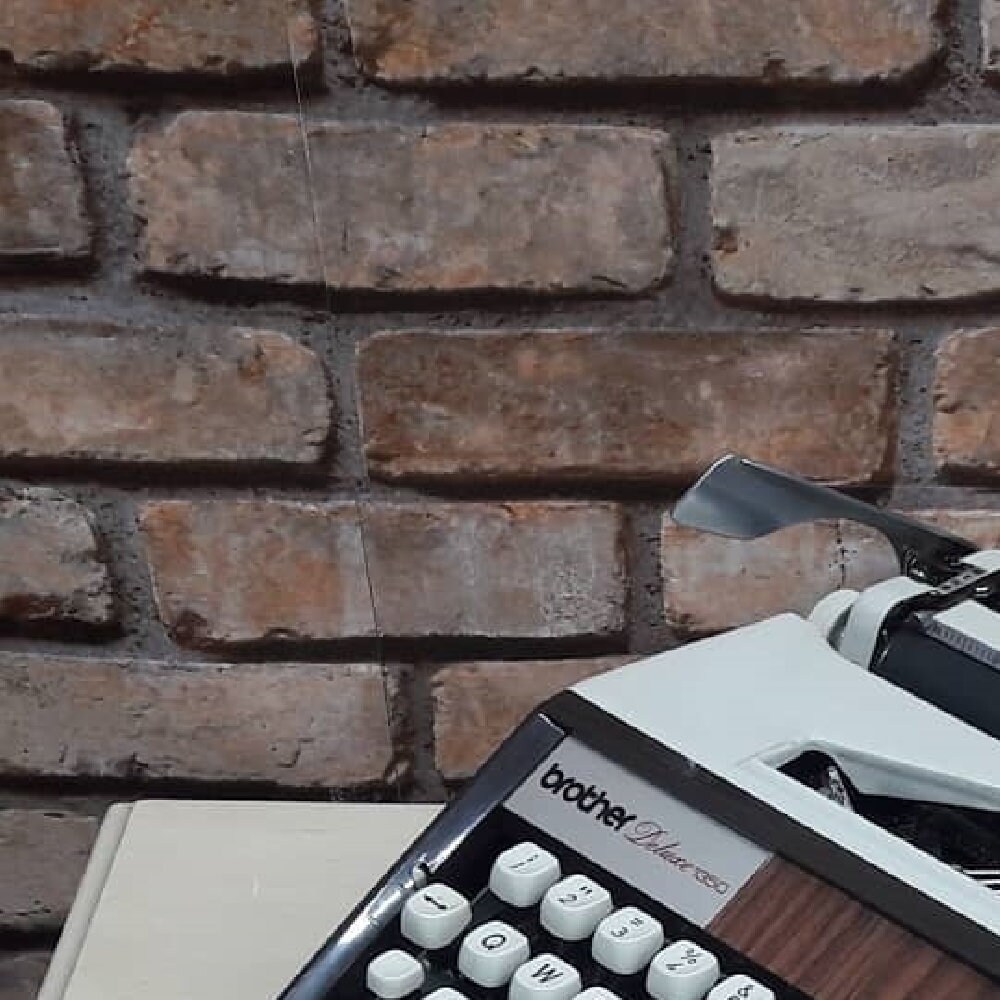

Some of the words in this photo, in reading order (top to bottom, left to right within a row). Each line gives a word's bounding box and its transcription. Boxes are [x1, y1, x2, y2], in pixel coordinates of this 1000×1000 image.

[541, 763, 637, 831] brother
[481, 935, 507, 950] Q
[531, 964, 563, 983] W
